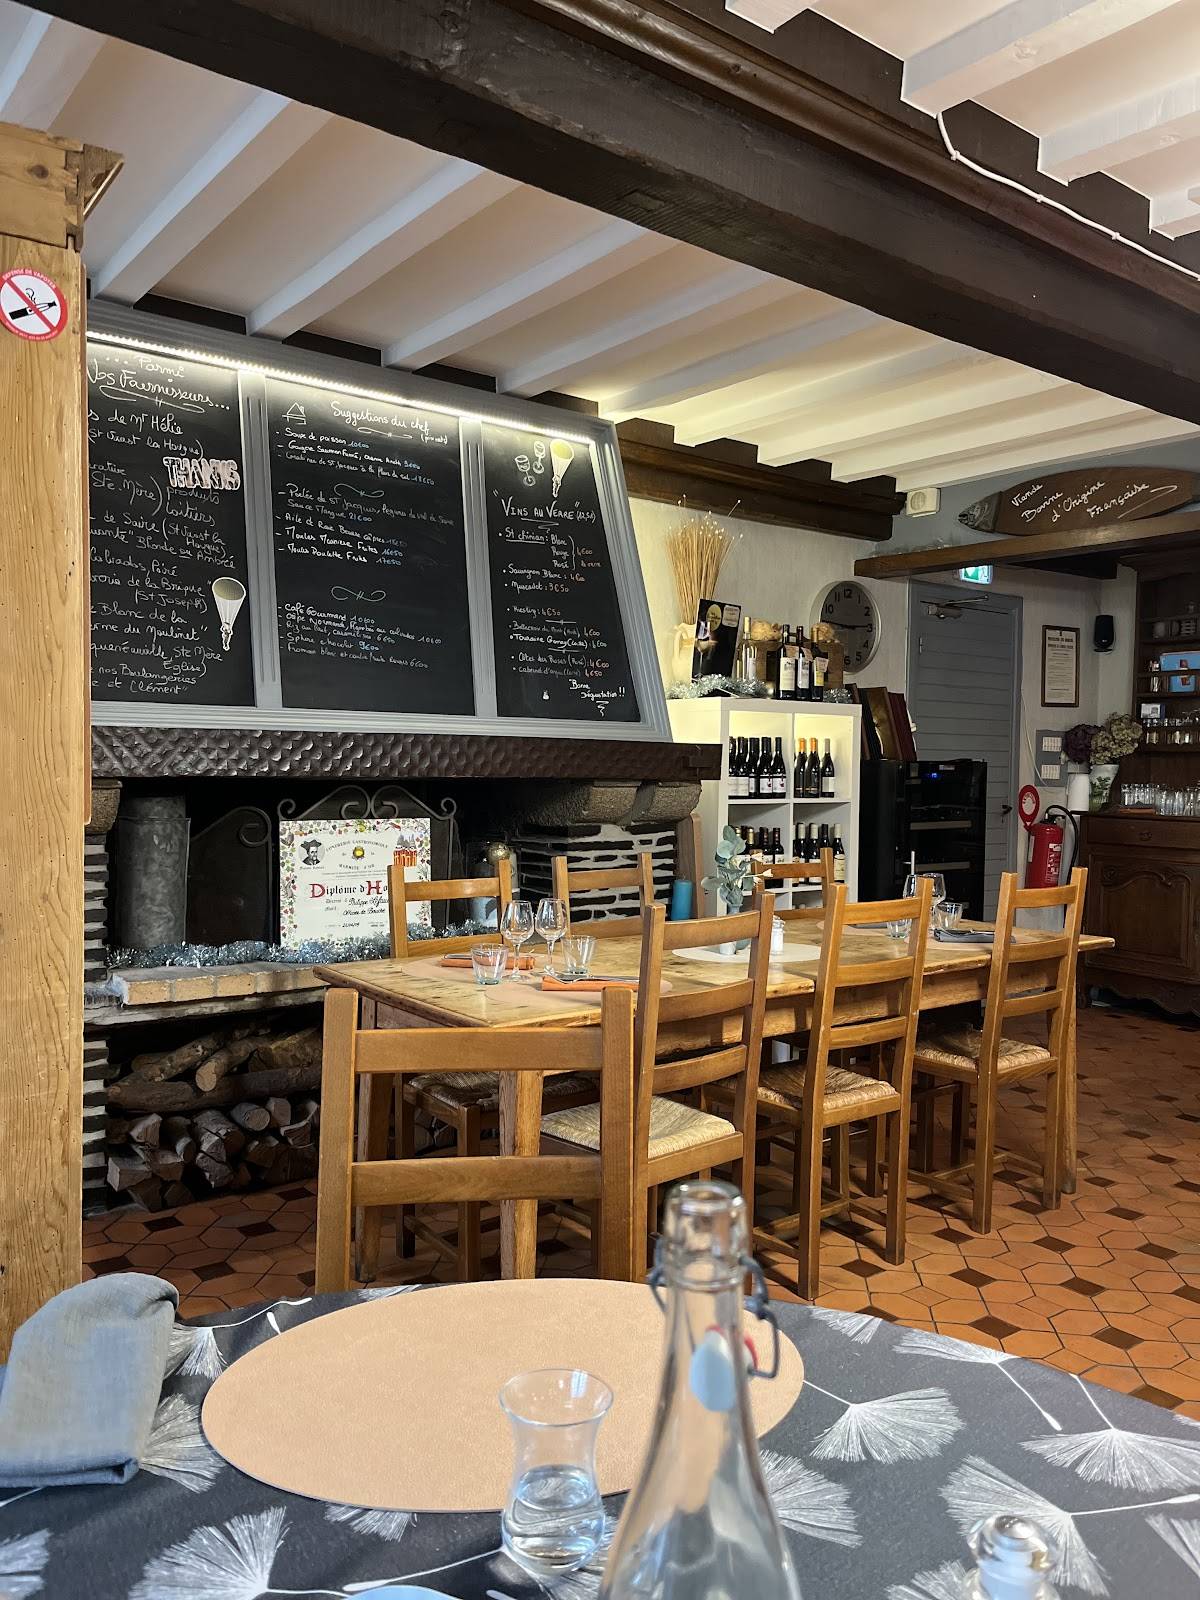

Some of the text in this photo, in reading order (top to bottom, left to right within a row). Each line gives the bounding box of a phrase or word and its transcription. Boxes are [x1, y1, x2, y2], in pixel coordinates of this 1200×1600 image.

[108, 408, 127, 425] de
[151, 412, 184, 435] Hélie
[331, 401, 430, 437] Suggestions du chef
[309, 432, 318, 441] de
[162, 456, 241, 491] THANKS
[1010, 482, 1044, 508] Viande
[1020, 490, 1065, 523] Bovine
[103, 510, 117, 524] de
[534, 508, 544, 518] AU
[506, 527, 515, 539] St
[136, 535, 178, 555] Blonde
[127, 574, 141, 587] de
[844, 589, 853, 600] 12
[285, 603, 305, 615] Café
[825, 604, 835, 615] 10
[865, 607, 871, 617] 2
[149, 607, 167, 624] de
[171, 609, 189, 625] la
[123, 622, 141, 634] du
[863, 640, 869, 650] 4
[856, 652, 863, 662] 5
[119, 663, 197, 686] Boulangeries
[569, 680, 591, 690] Bonne
